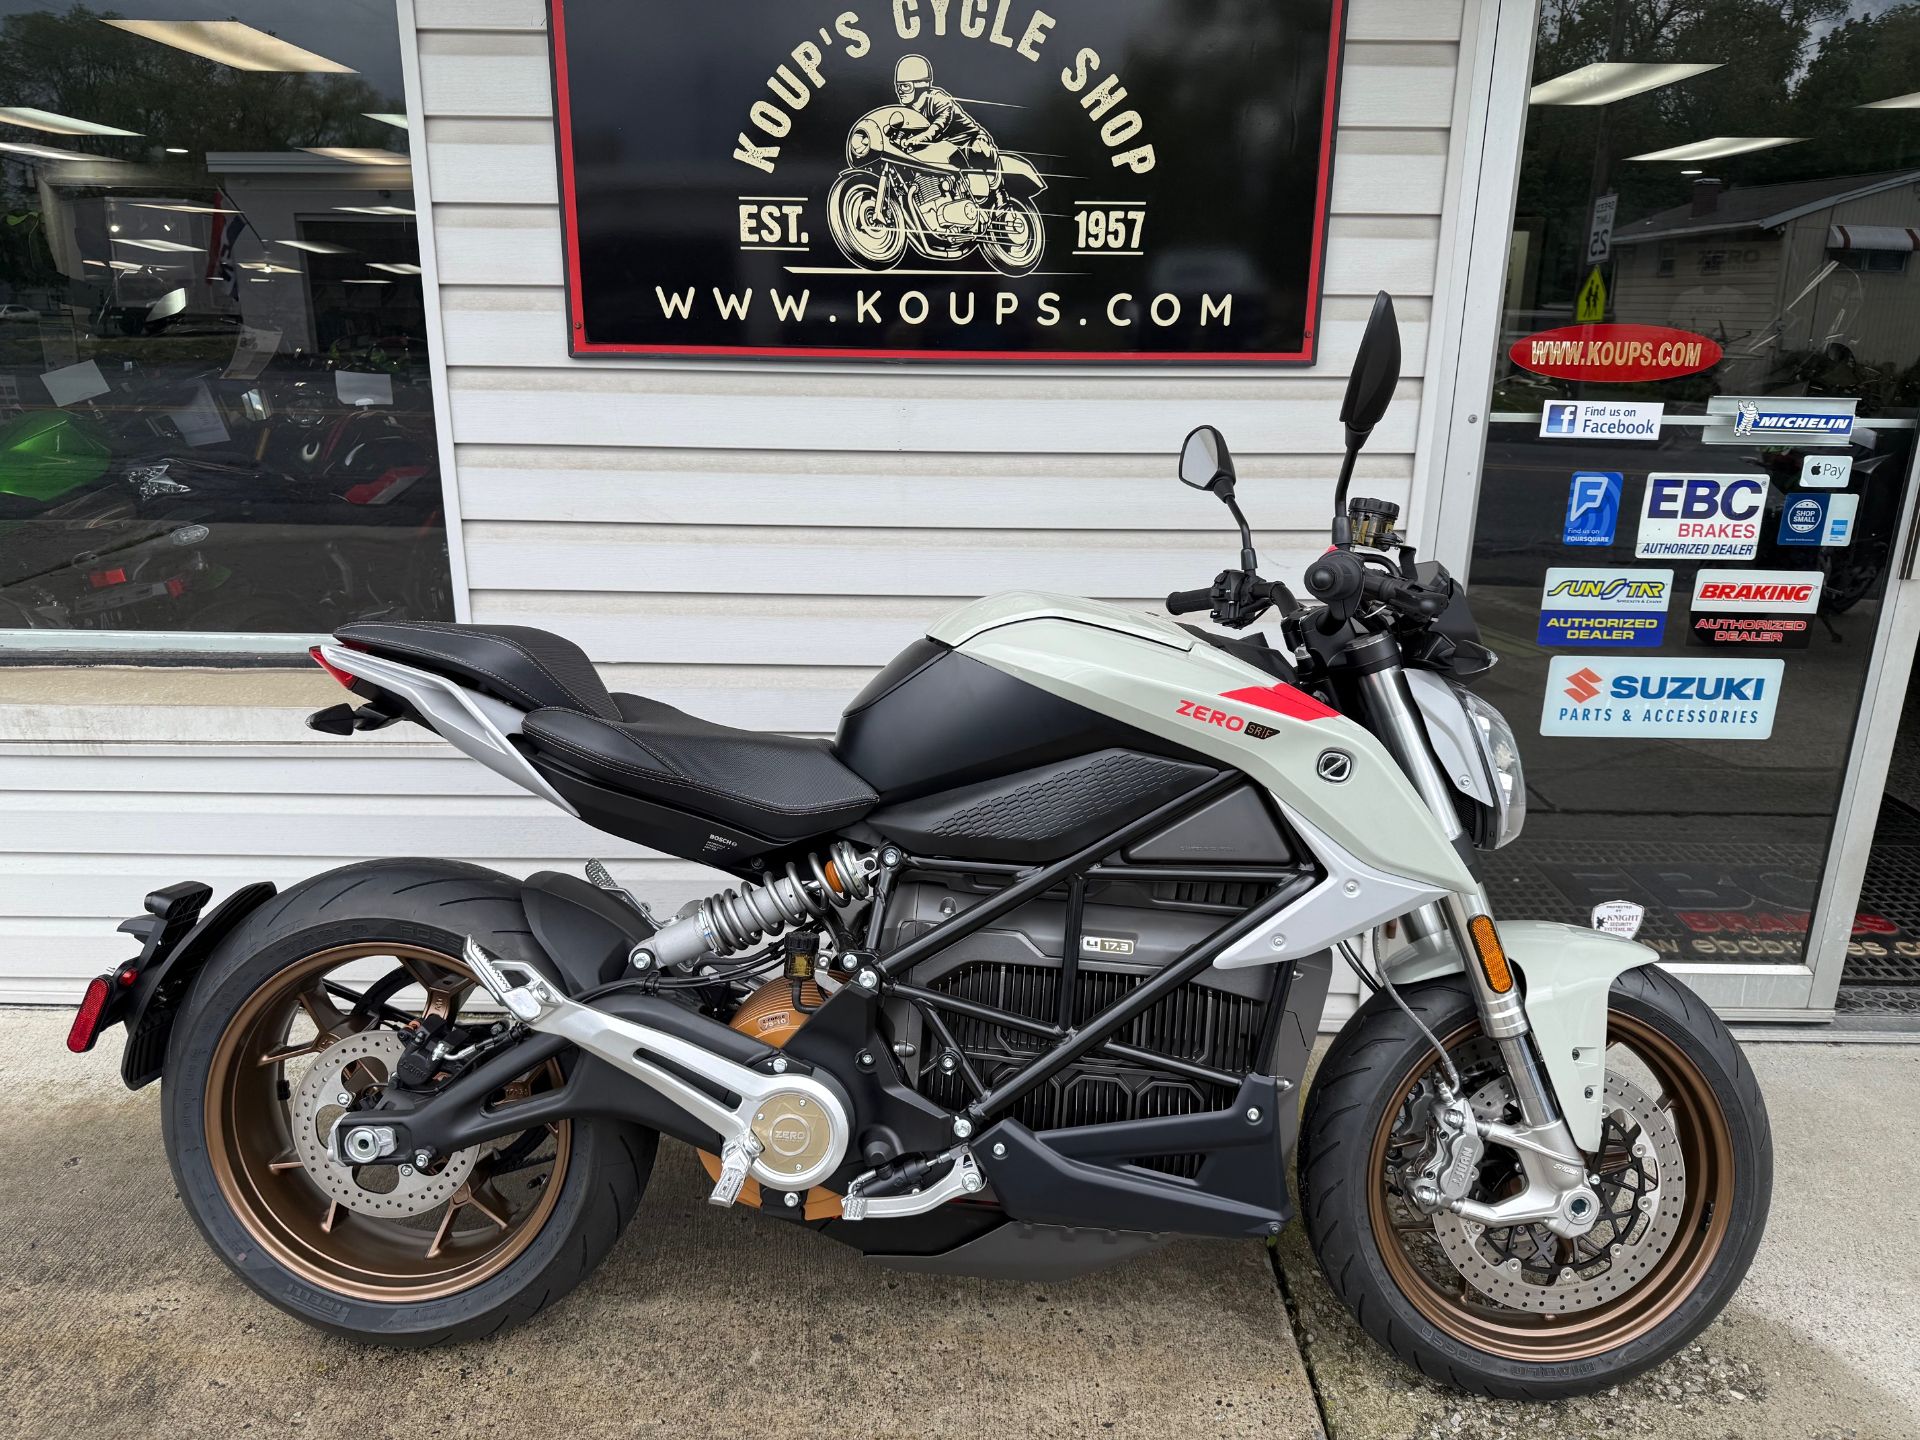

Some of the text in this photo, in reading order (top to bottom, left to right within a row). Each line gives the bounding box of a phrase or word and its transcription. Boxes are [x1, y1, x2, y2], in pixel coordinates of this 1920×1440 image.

[733, 0, 1156, 174] KOUP'S CYCLE SHOP
[740, 205, 809, 244] EST.
[1074, 210, 1144, 249] 1957
[654, 285, 1233, 328] WWW.KOUPS.COM
[1531, 340, 1702, 367] WWW.KOUPS.COM
[1584, 406, 1636, 417] Find us on
[1583, 419, 1654, 434] Facebook
[1758, 416, 1849, 429] MICHELIN
[1823, 463, 1846, 479] Pay
[1647, 479, 1763, 521] EBC
[1678, 523, 1756, 538] BRAKES
[1642, 543, 1753, 556] AUTHORIZED DEALER
[1697, 583, 1814, 603] BRAKING
[1546, 618, 1658, 629] AUTHORIZED
[1695, 618, 1807, 630] AUTHORIZED
[1566, 629, 1635, 640] DEALER
[1714, 631, 1784, 642] DEALER
[1610, 675, 1765, 700] SUZUKI
[1176, 699, 1245, 732] ZERO
[1559, 708, 1759, 724] PARTS & ACCESSORIES
[709, 834, 732, 845] BOSCH
[1675, 912, 1899, 935] BRAS
[1104, 941, 1129, 951] 17.3
[775, 1130, 805, 1140] ZERO
